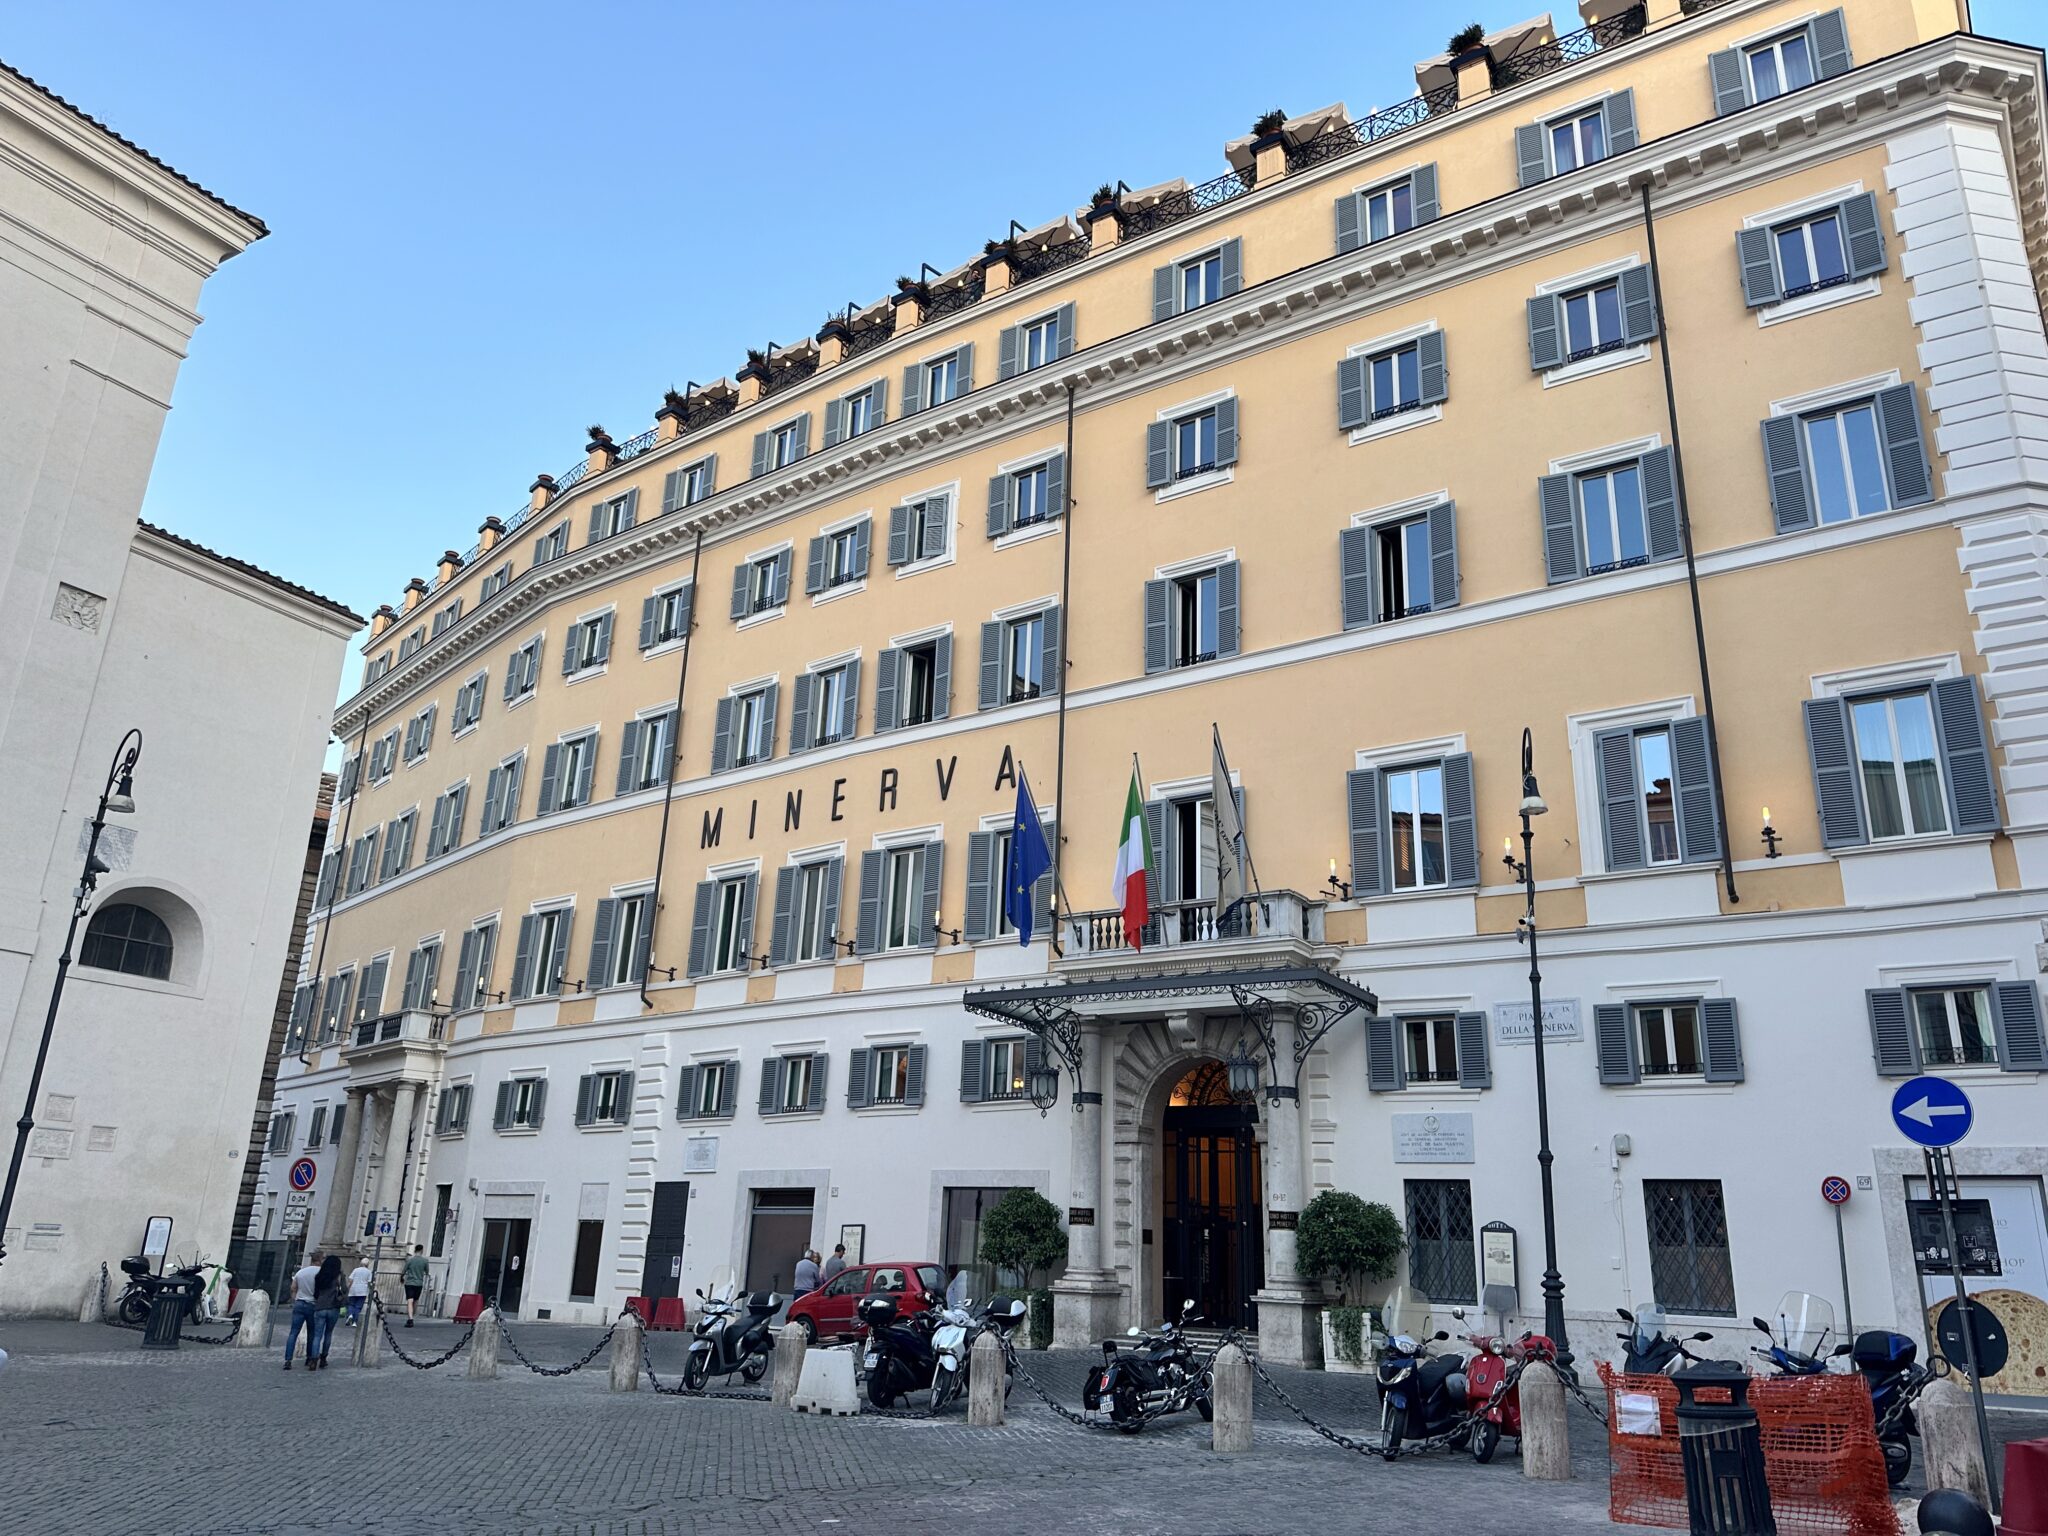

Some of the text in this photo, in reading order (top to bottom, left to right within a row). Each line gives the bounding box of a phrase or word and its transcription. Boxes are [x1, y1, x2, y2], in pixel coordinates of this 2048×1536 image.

[701, 745, 1016, 849] MINERVA
[1518, 1011, 1554, 1021] PIAZA
[1502, 1023, 1575, 1034] DELLA NERVA
[1859, 1178, 1870, 1186] 69
